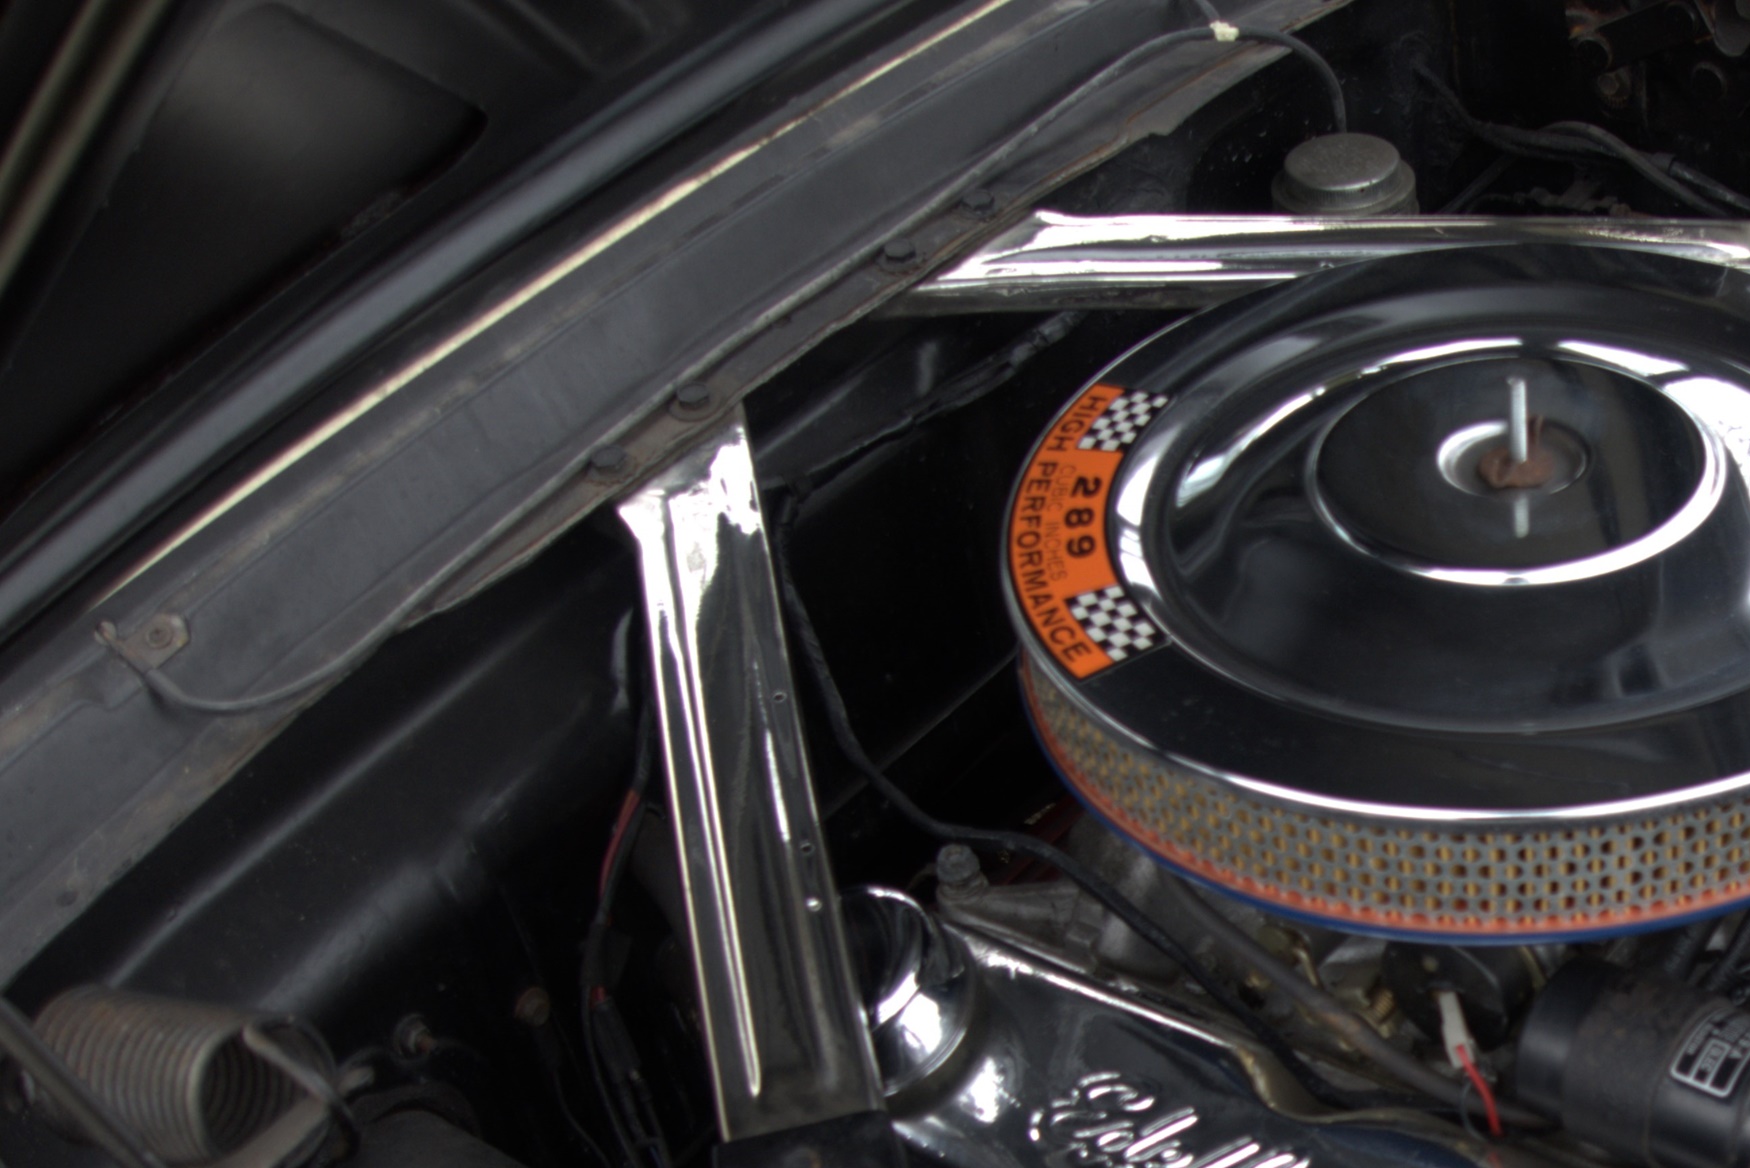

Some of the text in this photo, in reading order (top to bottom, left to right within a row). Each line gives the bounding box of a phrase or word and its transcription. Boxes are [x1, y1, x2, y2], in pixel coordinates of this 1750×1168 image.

[1016, 394, 1107, 662] HIGH PERFORMANCE
[1044, 464, 1076, 581] CUBIC INCHES
[1064, 475, 1103, 559] 289
